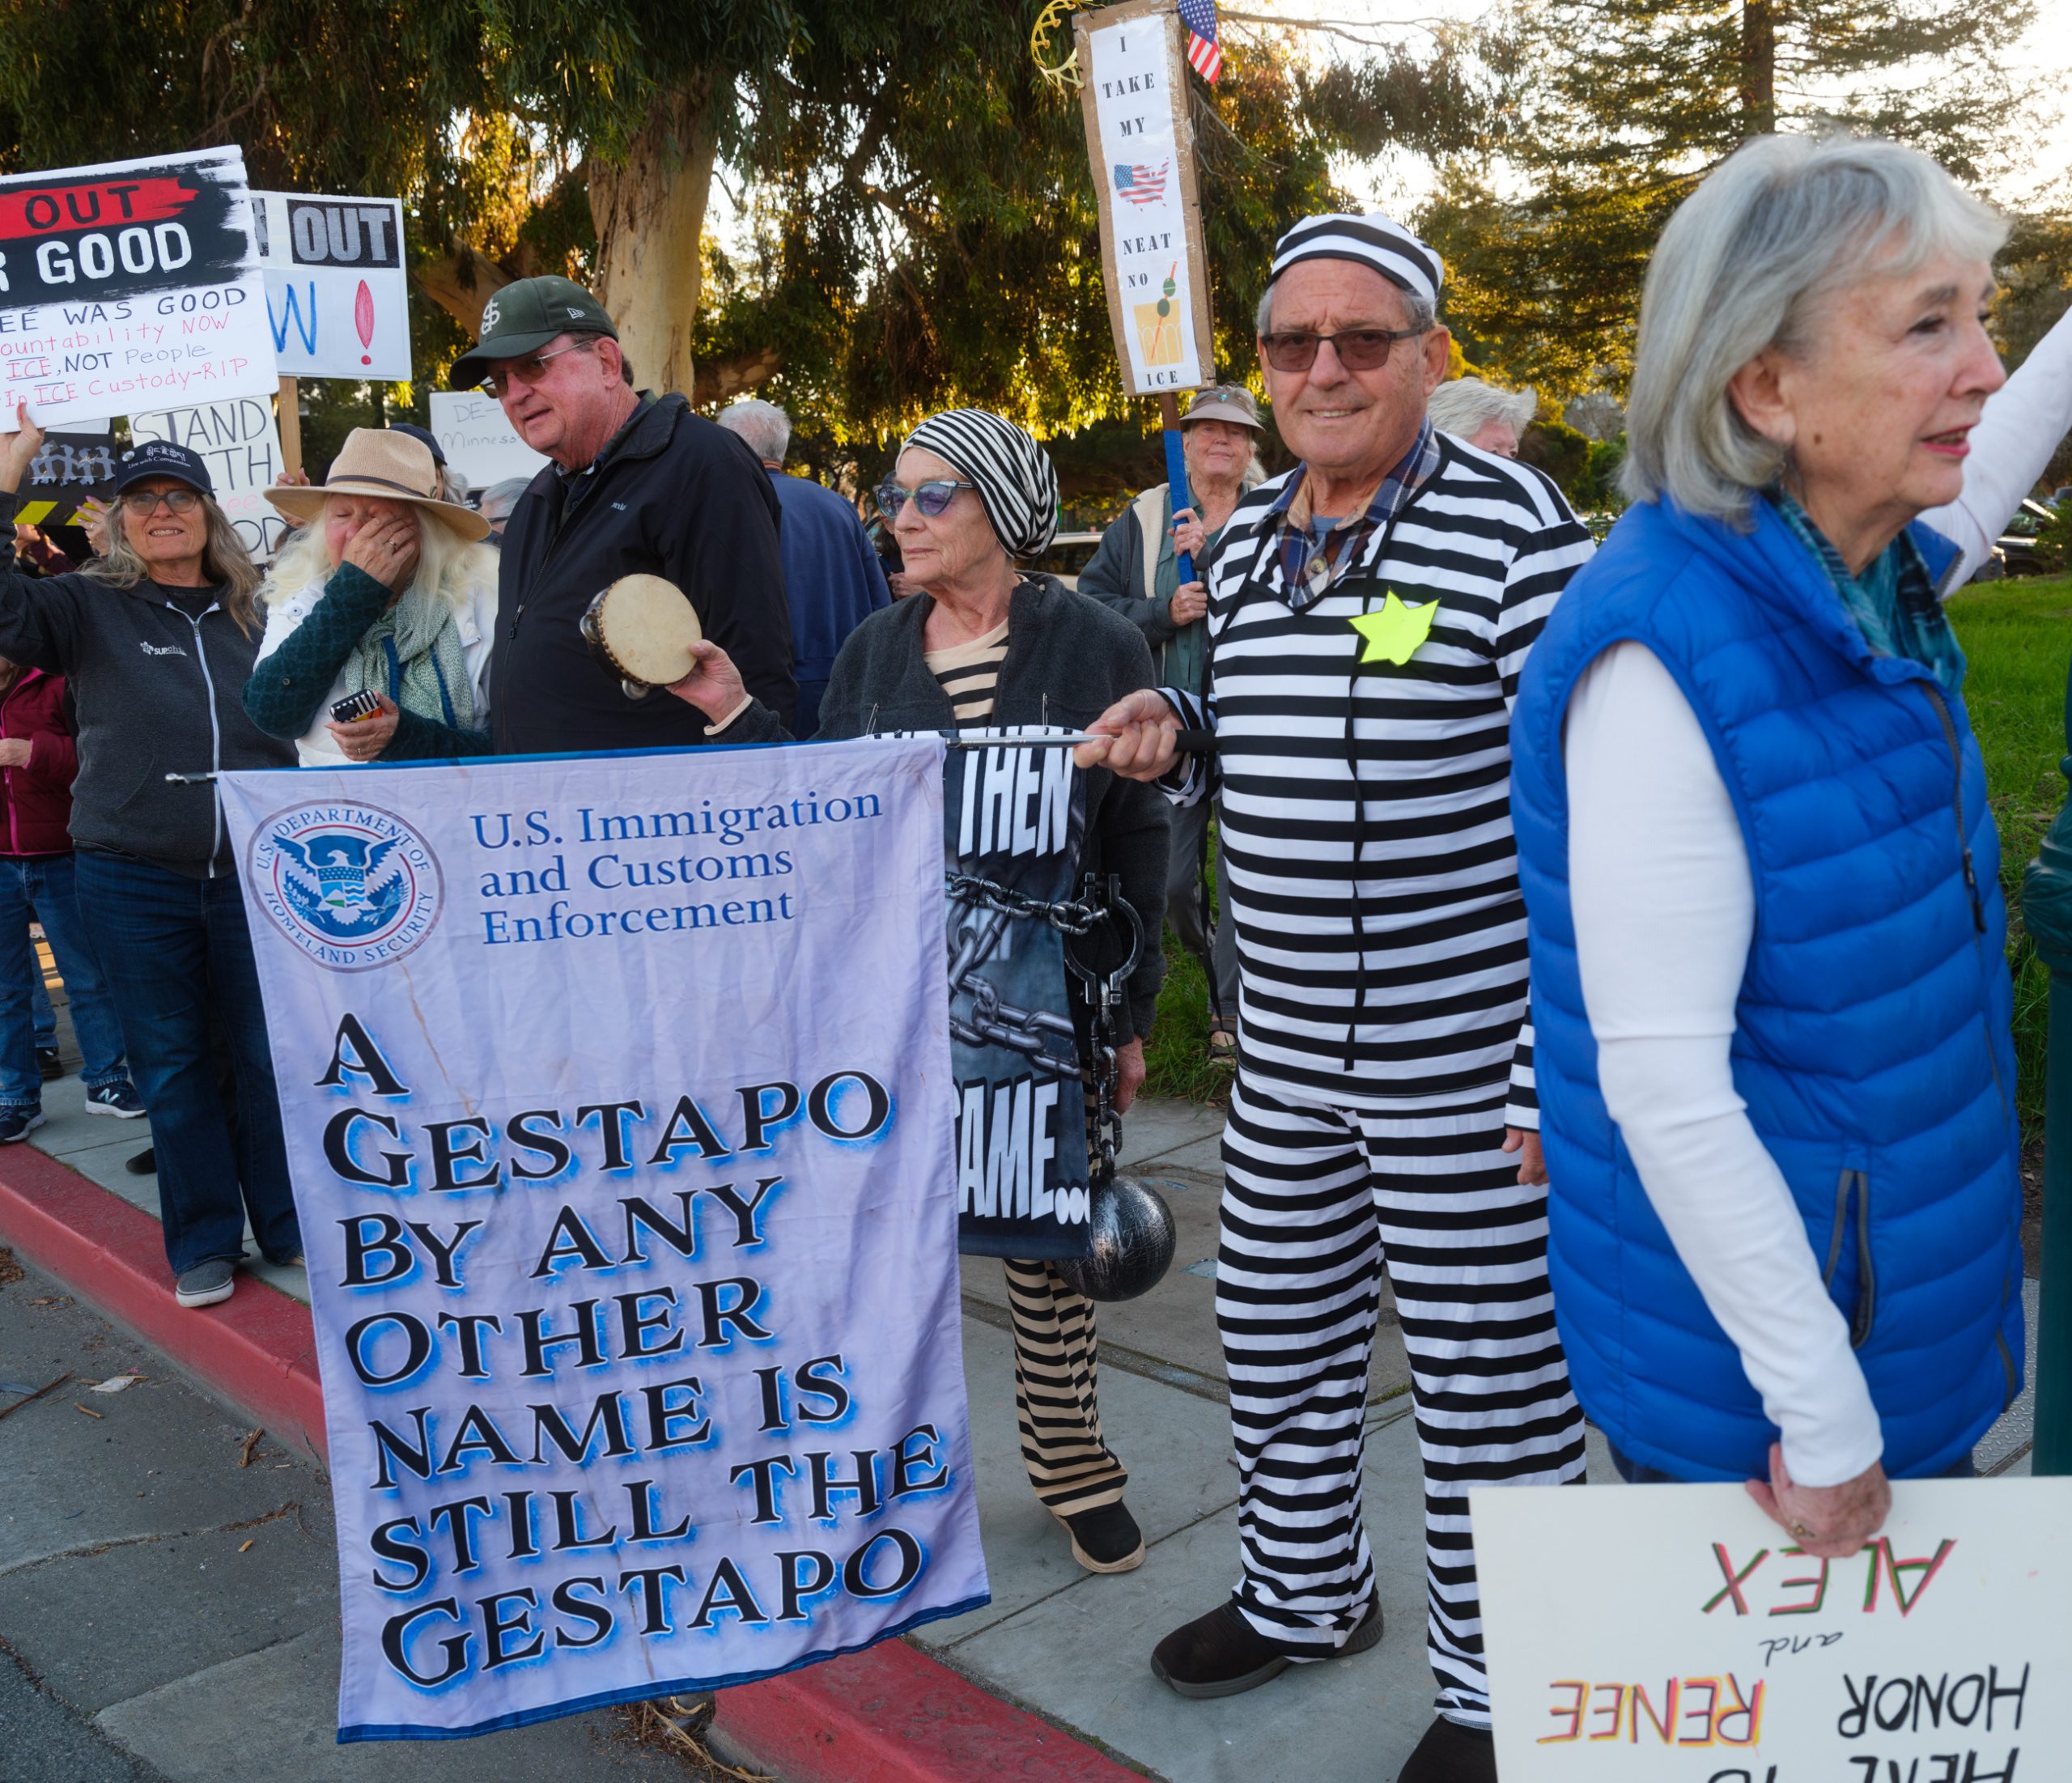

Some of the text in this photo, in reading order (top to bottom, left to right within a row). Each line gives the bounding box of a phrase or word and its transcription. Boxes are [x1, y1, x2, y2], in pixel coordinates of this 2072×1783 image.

[1119, 36, 1127, 53] I
[1102, 73, 1155, 99] TAKE
[1119, 117, 1145, 137] MY
[25, 185, 139, 229] OUT
[292, 206, 390, 261] OUT
[36, 223, 192, 284] GOOD
[1123, 232, 1171, 255] NEAT
[63, 301, 133, 325] WAS
[158, 287, 246, 316] GOOD
[1127, 273, 1149, 288] NO
[182, 312, 230, 333] NOW
[65, 352, 113, 372] NOT
[125, 343, 214, 365] People
[1146, 371, 1178, 386] ICE
[34, 383, 79, 405] ICE
[134, 400, 266, 448] STAND
[275, 809, 414, 847] DEPARTMENT
[410, 849, 431, 872] OF
[469, 791, 883, 849] U.S. Immigration
[480, 848, 794, 898] and Customs
[265, 891, 433, 964] HOMELAND SECURITY
[481, 892, 796, 945] Enforcement
[312, 1012, 411, 1097] A
[322, 1069, 891, 1193] GESTAPO
[335, 1175, 784, 1290] BY ANY
[344, 1276, 774, 1386] OTHER
[367, 1353, 851, 1490] NAME IS
[369, 1423, 949, 1593] STILL THE
[1701, 1536, 1959, 1618] ALEX
[380, 1527, 922, 1688] GESTAPO
[1758, 1632, 1844, 1667] and
[1536, 1662, 2030, 1747] HONOR RENEE
